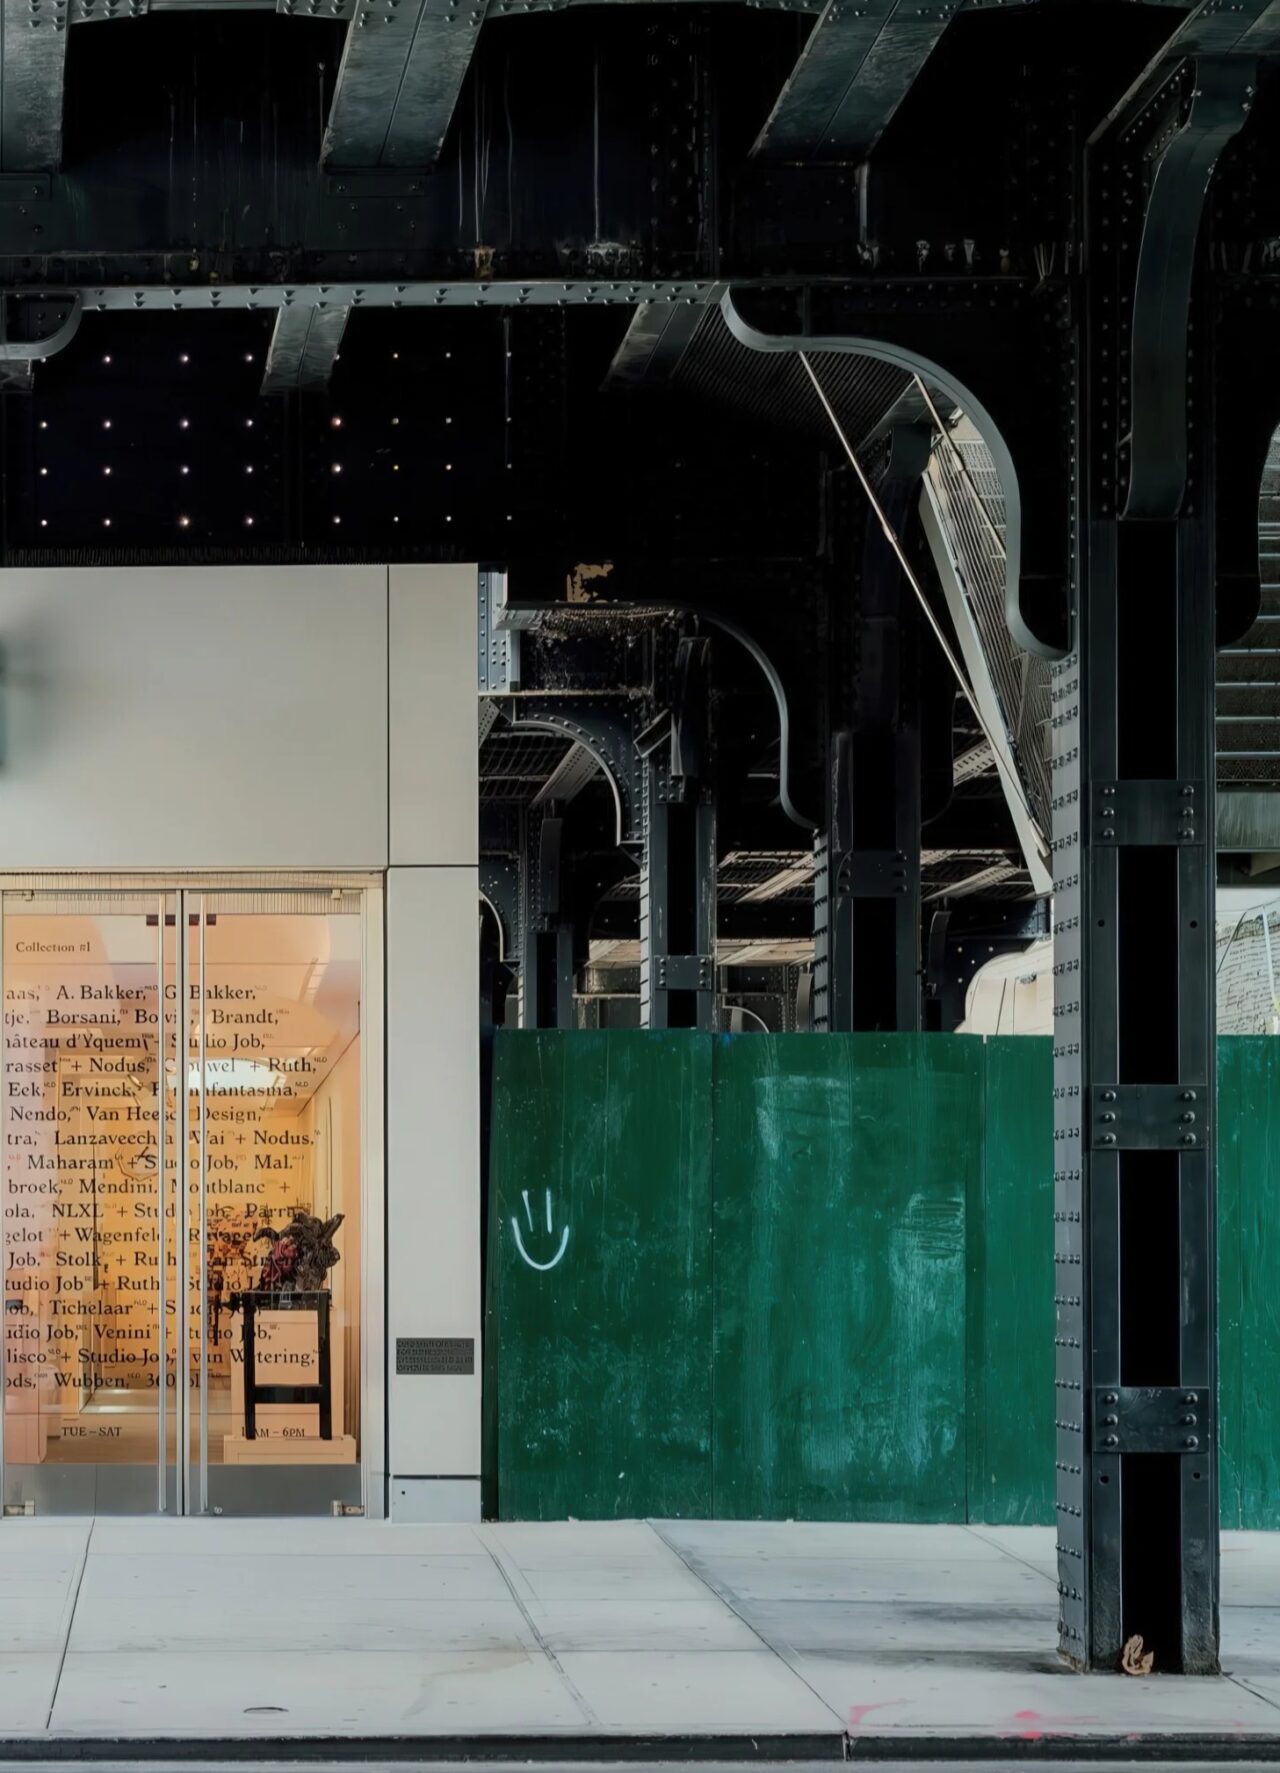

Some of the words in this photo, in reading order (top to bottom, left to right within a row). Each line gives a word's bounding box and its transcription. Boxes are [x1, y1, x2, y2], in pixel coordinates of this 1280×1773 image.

[15, 941, 74, 953] Collection
[56, 985, 75, 1000] A.
[80, 984, 147, 1001] Bakker,
[189, 984, 256, 1001] Bkker,
[46, 1008, 121, 1027] Borsani,
[211, 1008, 279, 1026] Brandt,
[232, 1033, 265, 1053] Job,
[88, 1057, 151, 1075] Nodus,
[268, 1057, 317, 1075] Ruth,
[8, 1080, 46, 1098] Eek,
[61, 1080, 136, 1098] Ervinck,
[10, 1105, 71, 1123] Nendo,
[86, 1106, 120, 1122] Van
[54, 1130, 174, 1146] Lanzaveccha
[27, 1154, 114, 1171] Maharam
[8, 1179, 63, 1196] broek,
[51, 1203, 104, 1218] NLXL
[73, 1227, 173, 1246] Wagenfel,
[133, 1252, 177, 1268] Ruh
[55, 1276, 84, 1295] Job
[48, 1300, 134, 1316] Tichelaar
[46, 1324, 79, 1344] Job,
[94, 1324, 152, 1341] Venini
[77, 1348, 137, 1365] Studio
[230, 1348, 316, 1368] Wtering,
[53, 1372, 130, 1392] Wubben,
